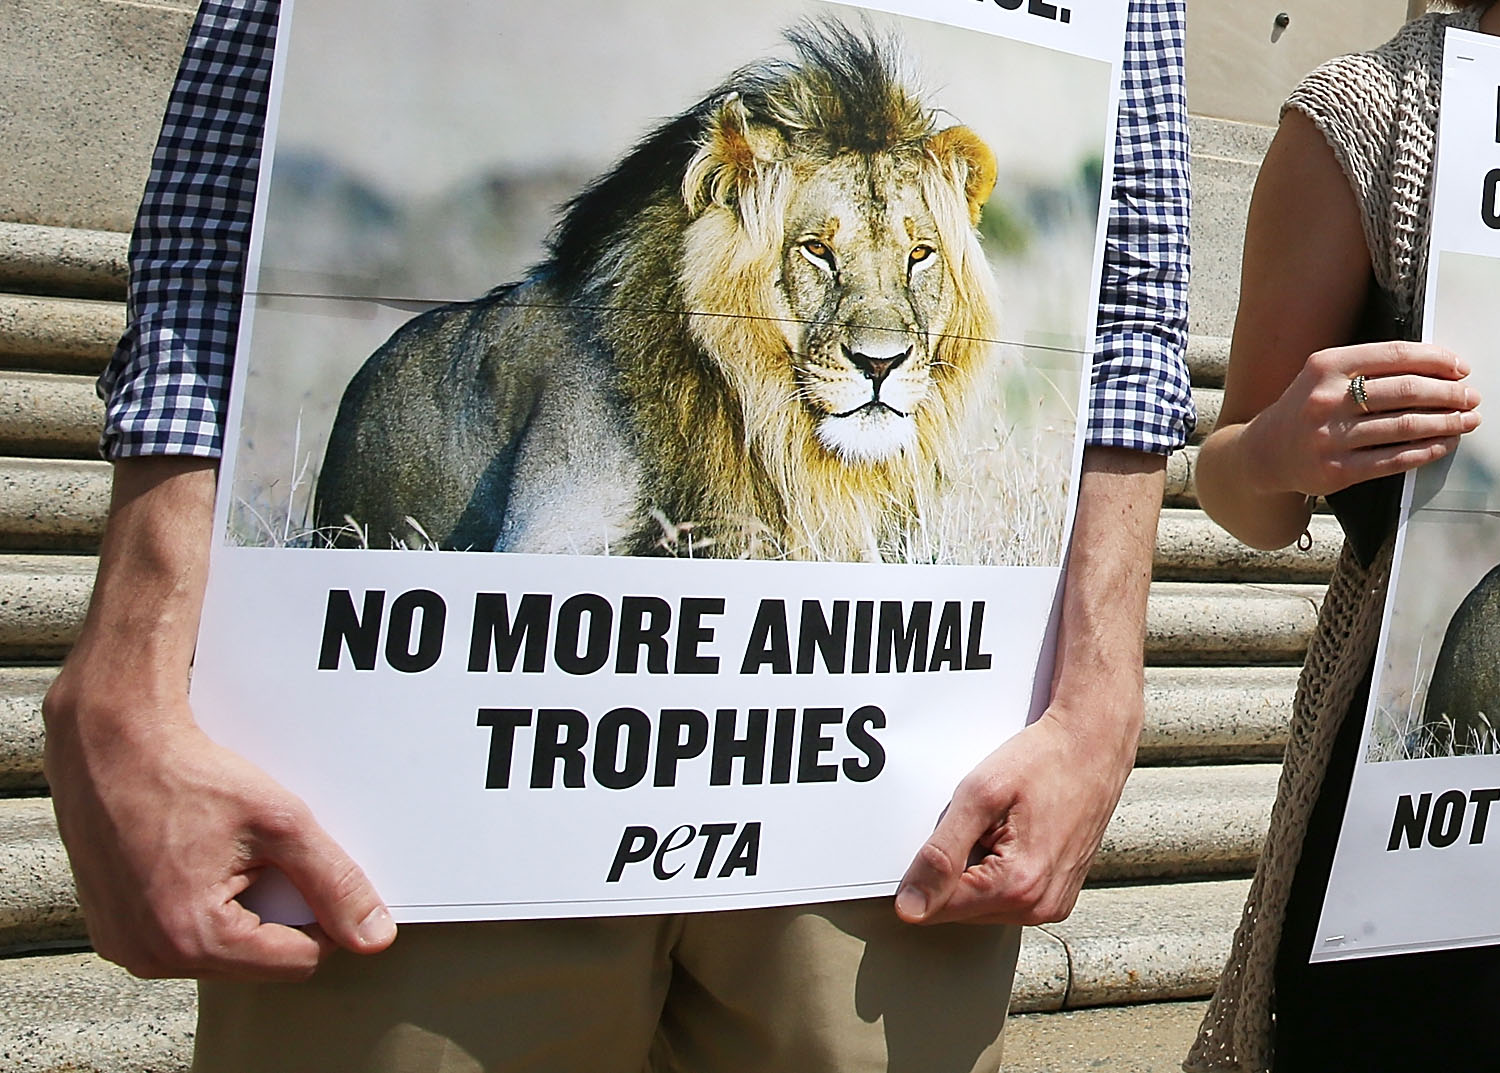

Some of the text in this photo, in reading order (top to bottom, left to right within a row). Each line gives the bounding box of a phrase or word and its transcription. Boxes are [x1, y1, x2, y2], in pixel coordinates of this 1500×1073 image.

[318, 588, 992, 675] NO MORE ANIMAL
[476, 704, 887, 790] TROPHIES
